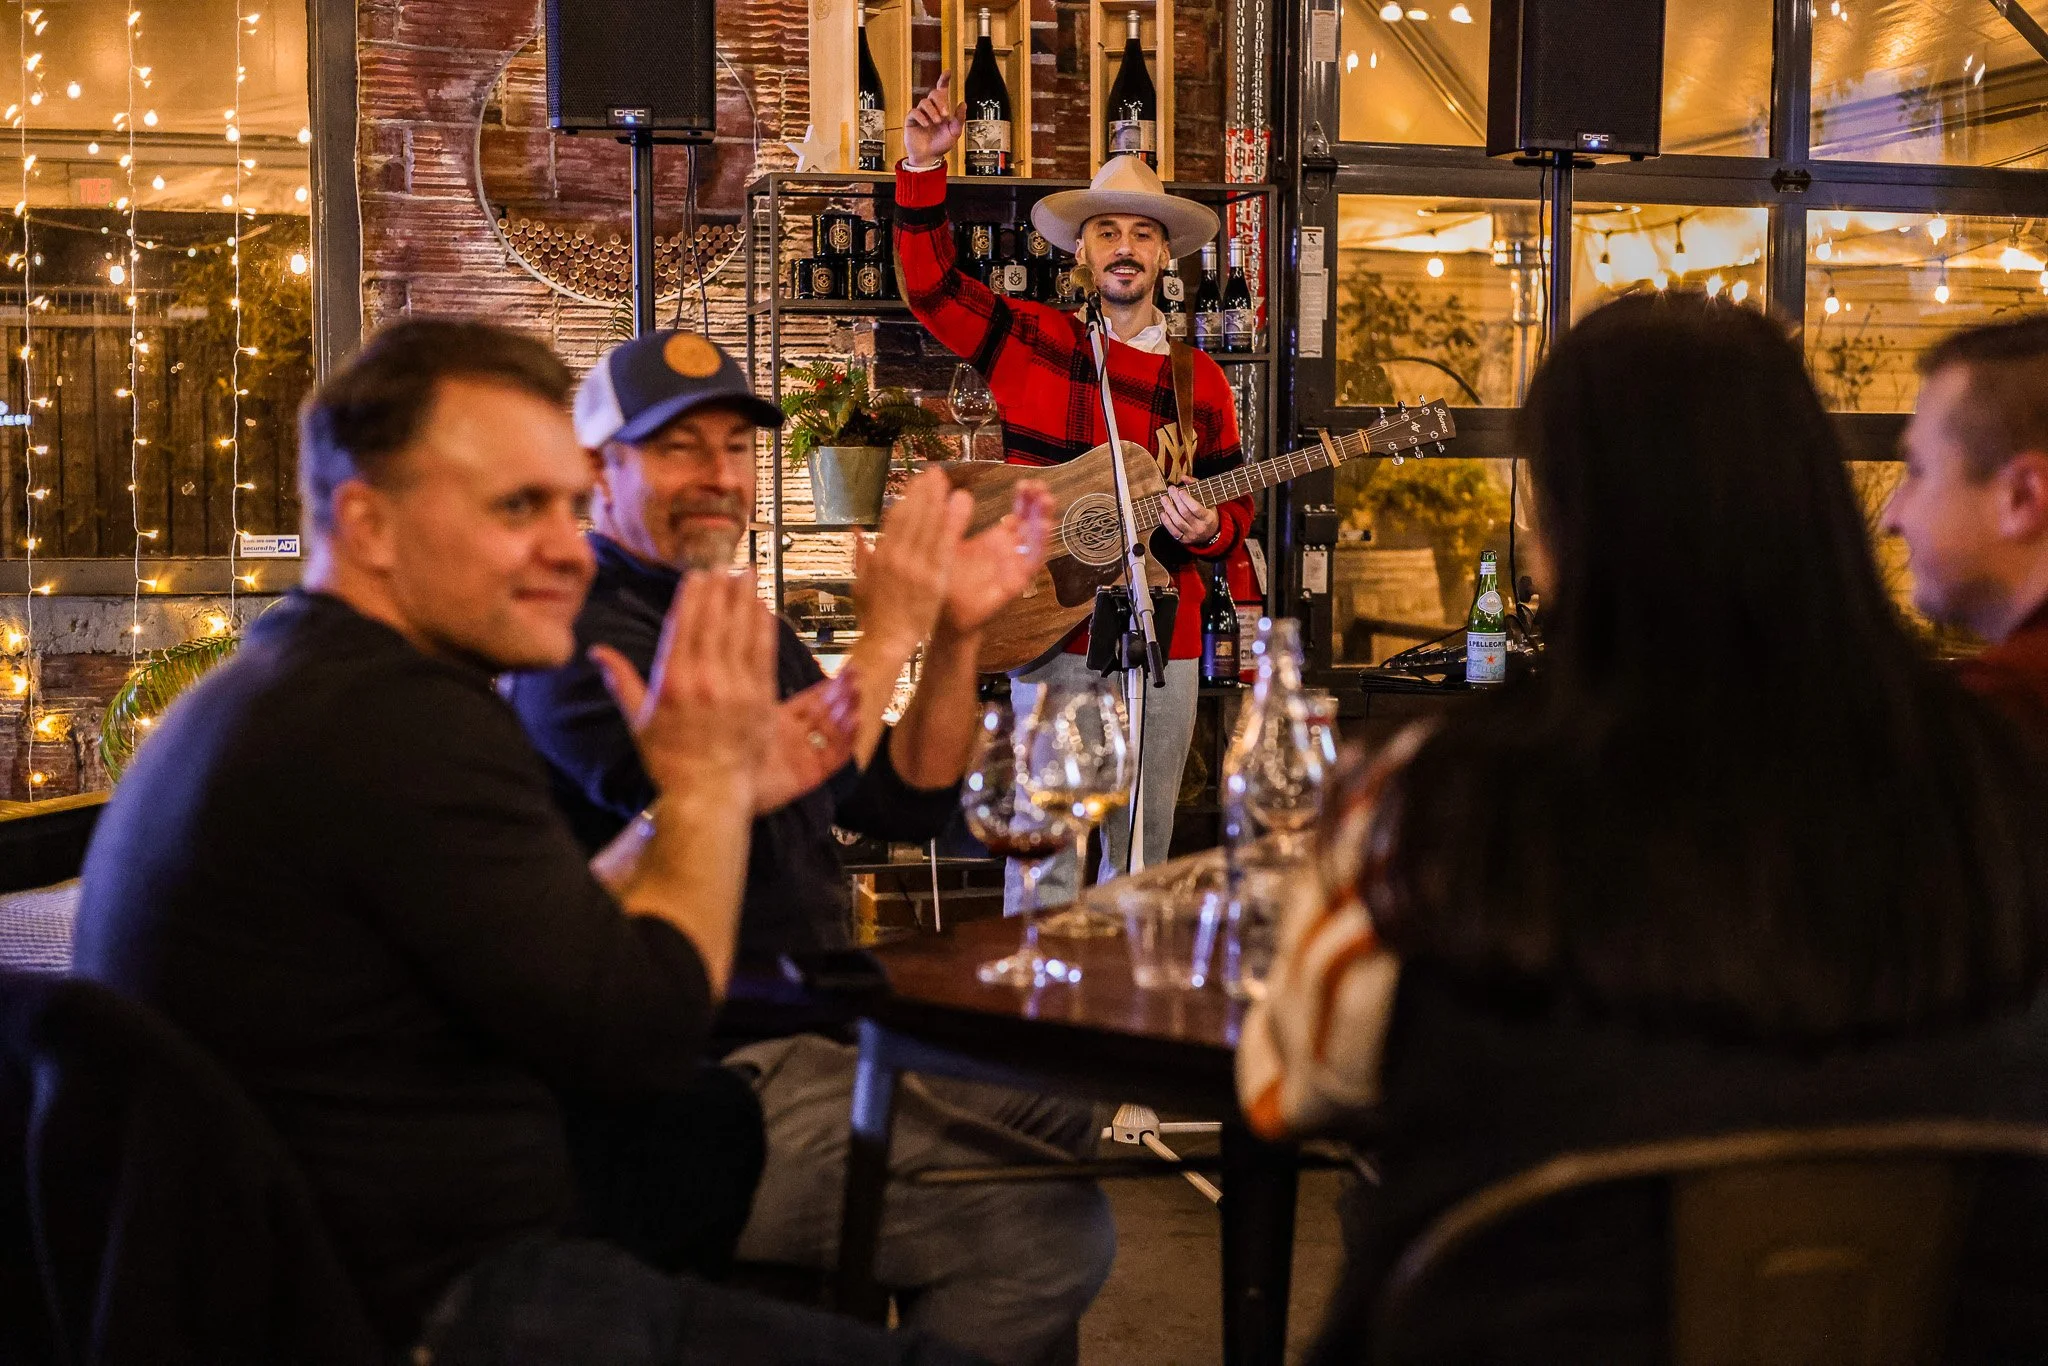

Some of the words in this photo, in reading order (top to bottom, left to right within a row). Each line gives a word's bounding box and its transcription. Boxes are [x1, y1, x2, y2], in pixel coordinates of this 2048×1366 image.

[1434, 407, 1448, 433] Ibanez
[1155, 421, 1198, 484] NY
[278, 541, 296, 551] ADT
[819, 604, 836, 612] LIVE
